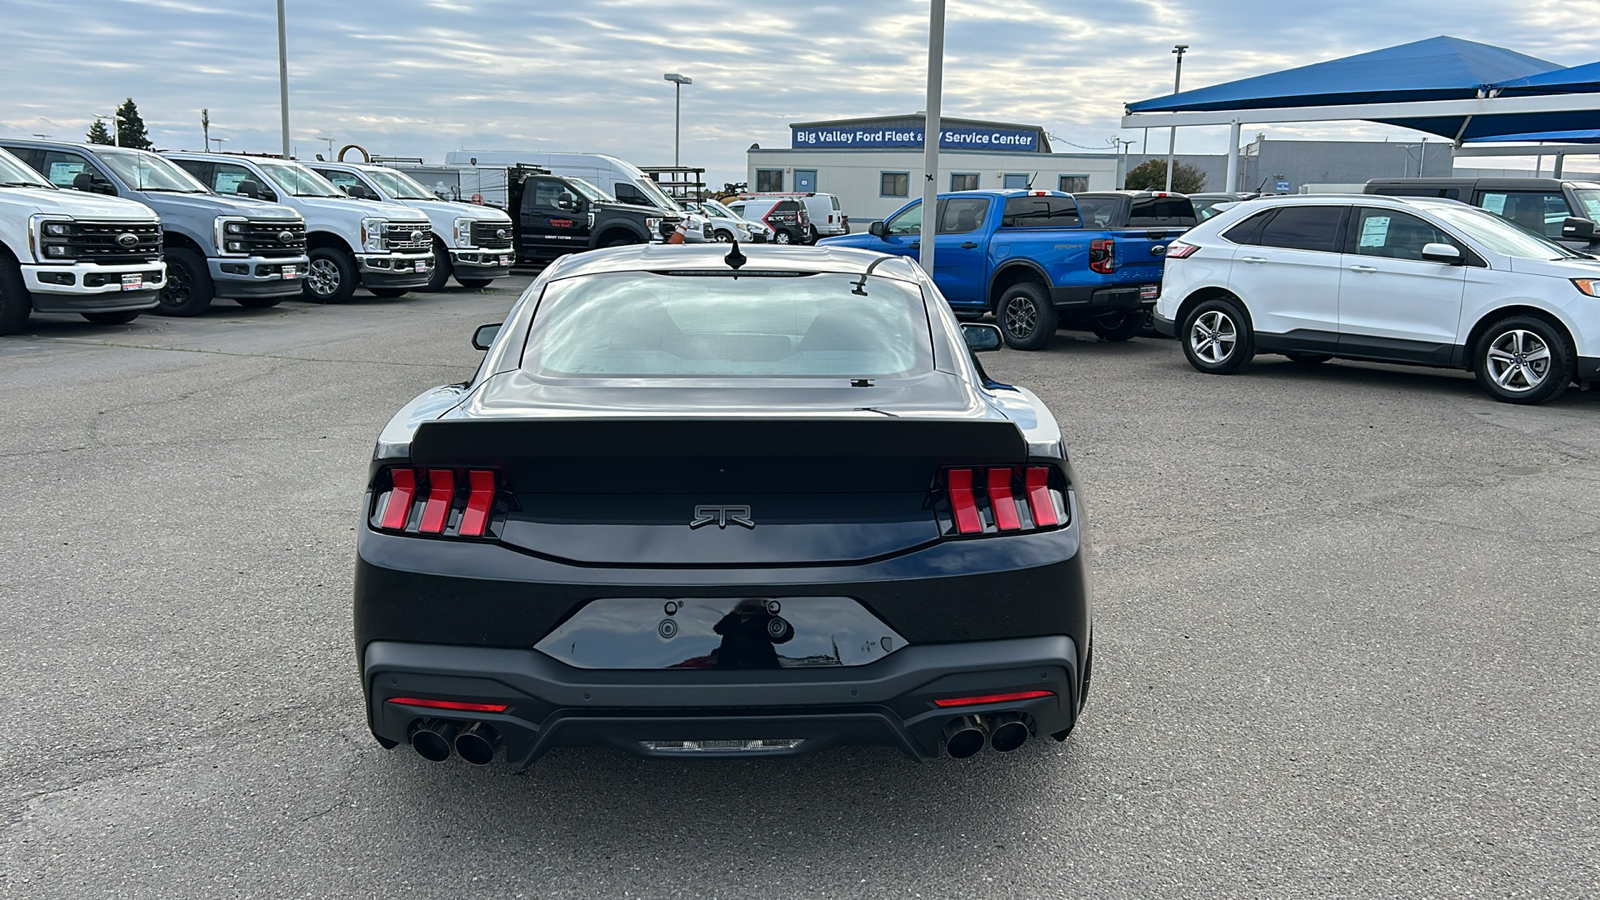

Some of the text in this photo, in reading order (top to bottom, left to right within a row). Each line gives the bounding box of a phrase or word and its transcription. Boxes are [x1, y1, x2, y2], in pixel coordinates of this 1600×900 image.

[797, 131, 816, 143] Big
[818, 131, 854, 143] Valley
[856, 131, 882, 142] Ford
[885, 131, 915, 142] Fleet
[917, 133, 923, 141] &
[945, 132, 989, 143] Service
[991, 133, 1032, 145] Center
